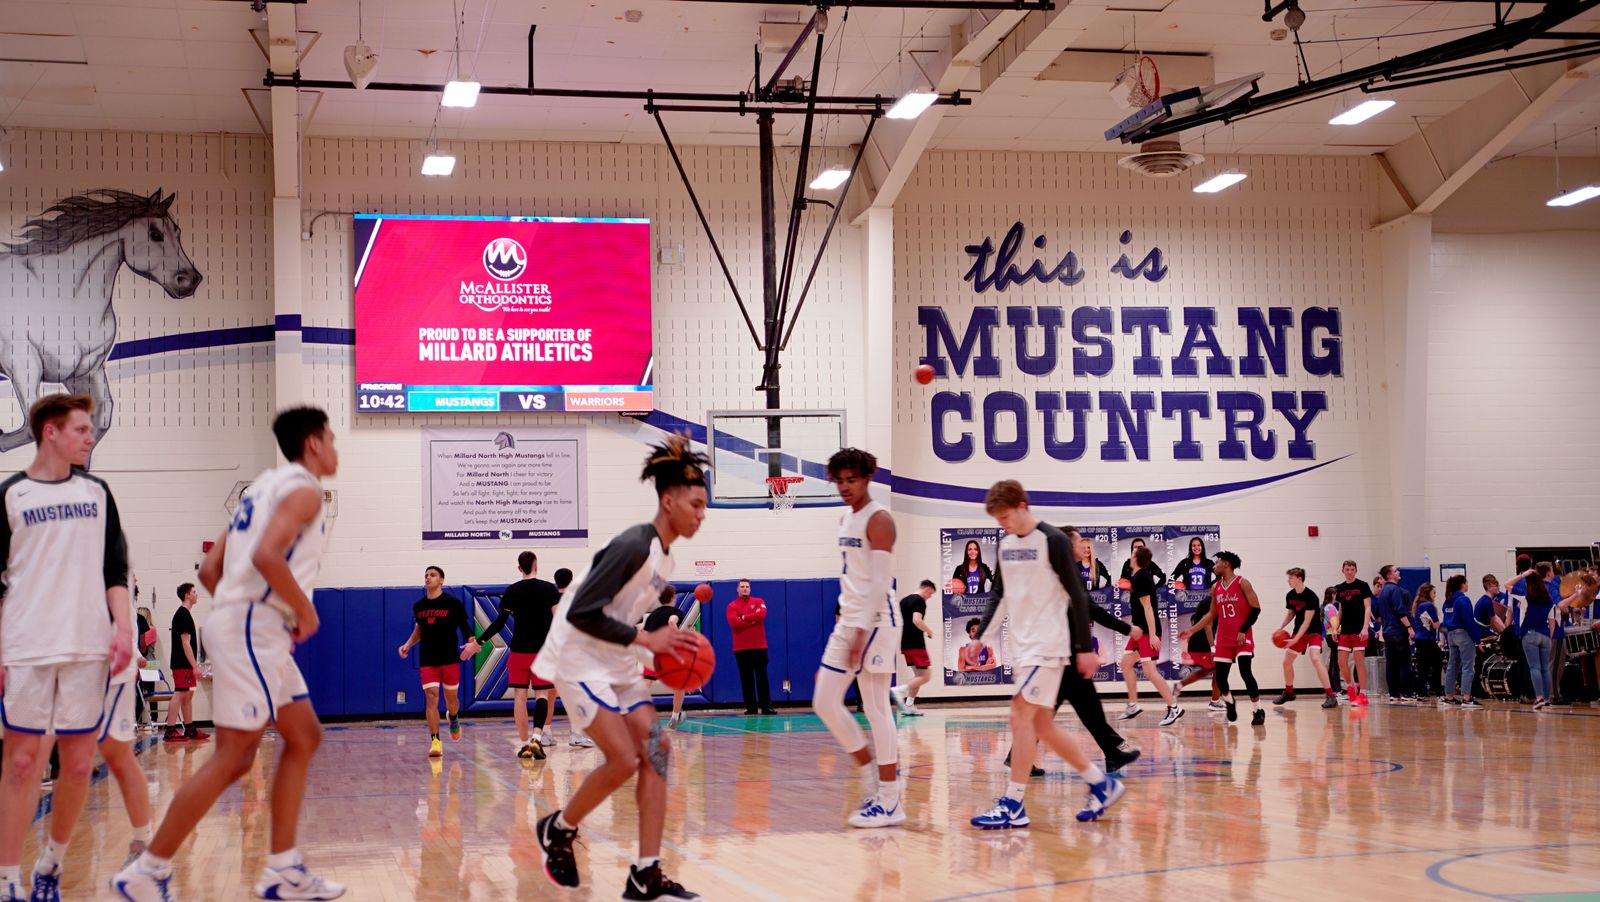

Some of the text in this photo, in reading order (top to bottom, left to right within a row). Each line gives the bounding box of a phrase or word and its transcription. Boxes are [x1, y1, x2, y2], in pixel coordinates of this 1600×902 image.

[963, 221, 1168, 293] this is
[459, 295, 552, 305] ORTHODONTICS
[419, 327, 592, 342] PROUD TO BE A SUPPORTER OF
[918, 306, 1343, 378] MUSTANG
[419, 342, 592, 362] MILLARD ATHLETICS
[360, 394, 405, 408] 10:42
[435, 397, 494, 407] MUSTANGS
[518, 394, 546, 410] VS
[570, 397, 624, 406] WARRIORS
[931, 391, 1328, 462] COUNTRY
[22, 502, 98, 527] MUSTANGS
[1095, 534, 1108, 542] #20
[1204, 533, 1218, 541] #33
[942, 531, 952, 571] DANLEY
[1168, 575, 1176, 595] ASIA
[1191, 575, 1202, 585] 33
[1222, 604, 1236, 618] 13
[1170, 603, 1180, 670] MAX MURRELL
